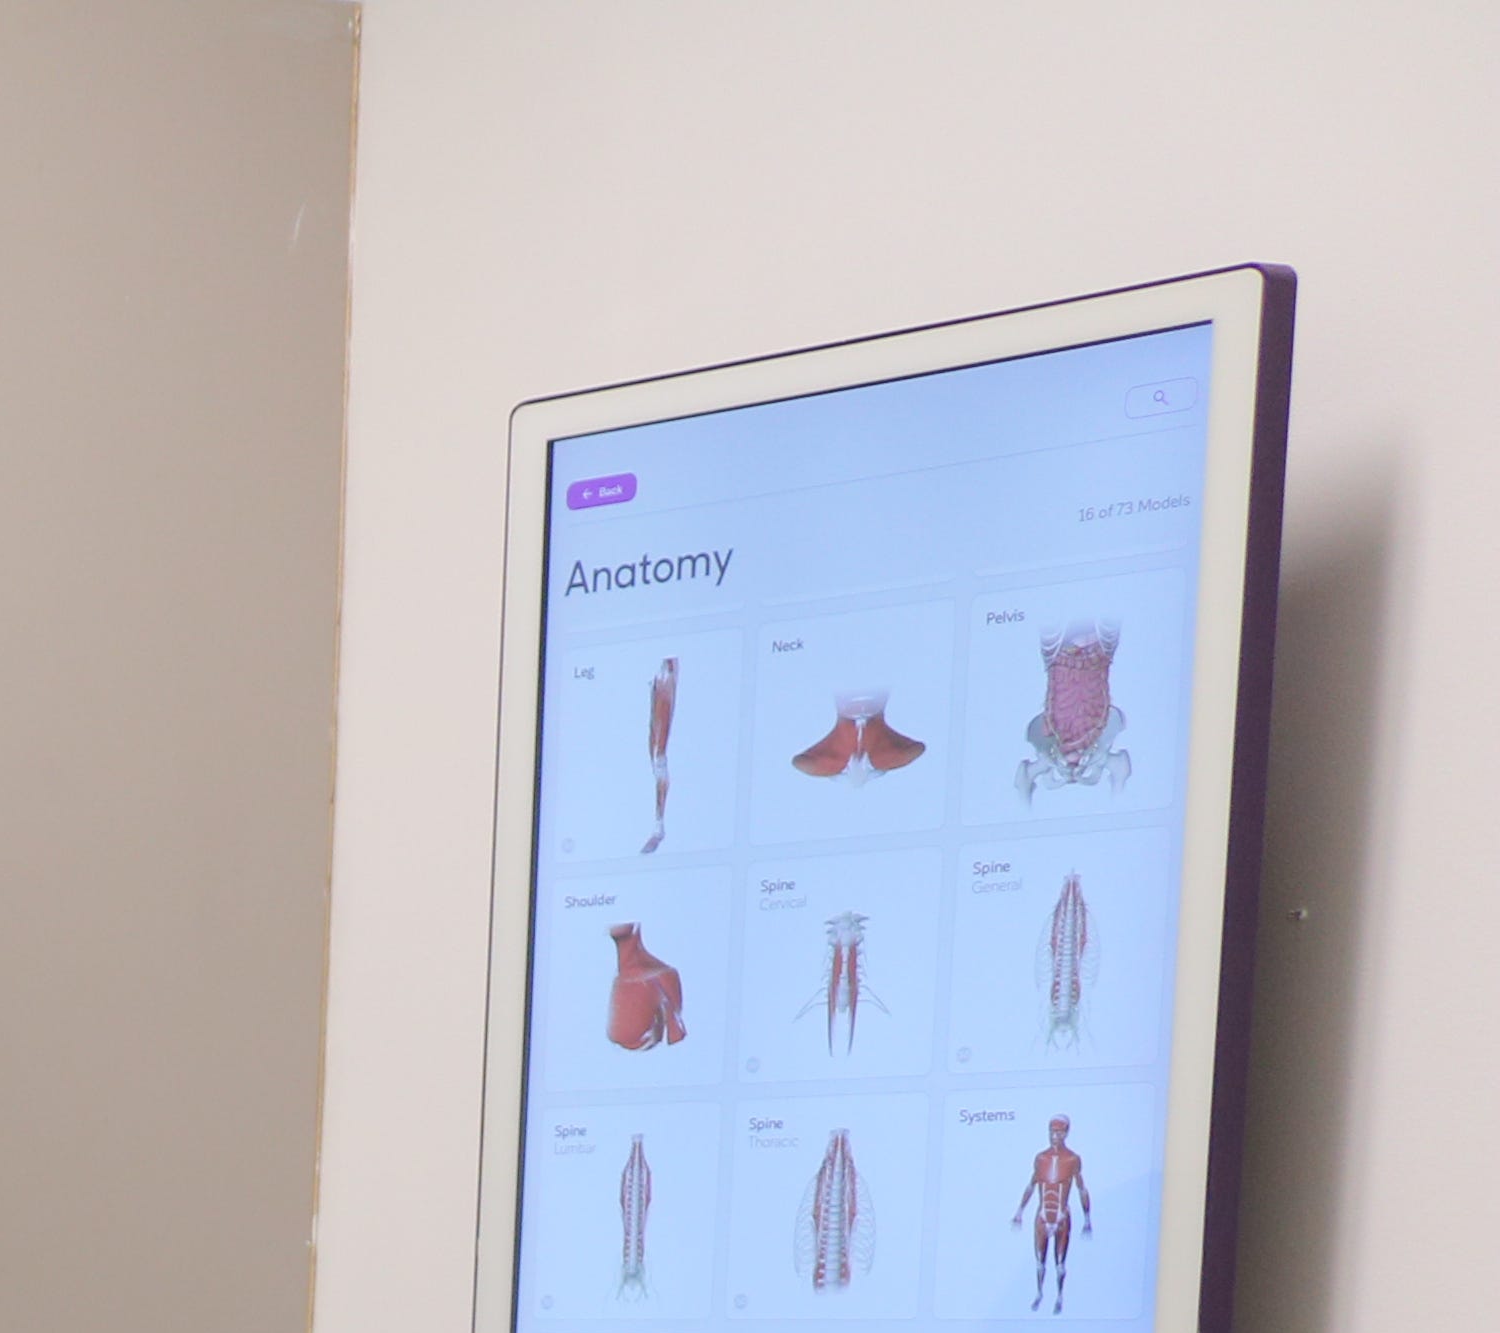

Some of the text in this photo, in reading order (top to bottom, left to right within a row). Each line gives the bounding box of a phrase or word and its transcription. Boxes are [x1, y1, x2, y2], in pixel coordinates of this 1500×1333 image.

[599, 484, 624, 498] Back
[1078, 494, 1192, 522] 16 of 73 Models
[564, 548, 734, 597] Anatomy
[986, 608, 1026, 625] Pelvis
[772, 638, 804, 653] Neck
[574, 666, 595, 680] Leg
[972, 860, 1012, 877] Spine
[760, 878, 796, 894] Spine
[971, 877, 1023, 895] General
[564, 893, 617, 909] Shoulder
[759, 895, 807, 911] Cervical
[749, 1117, 784, 1133] Spine
[959, 1109, 1016, 1126] Systems
[554, 1124, 588, 1140] Spine
[554, 1142, 597, 1155] Lumbar
[748, 1135, 800, 1149] Thoracic
